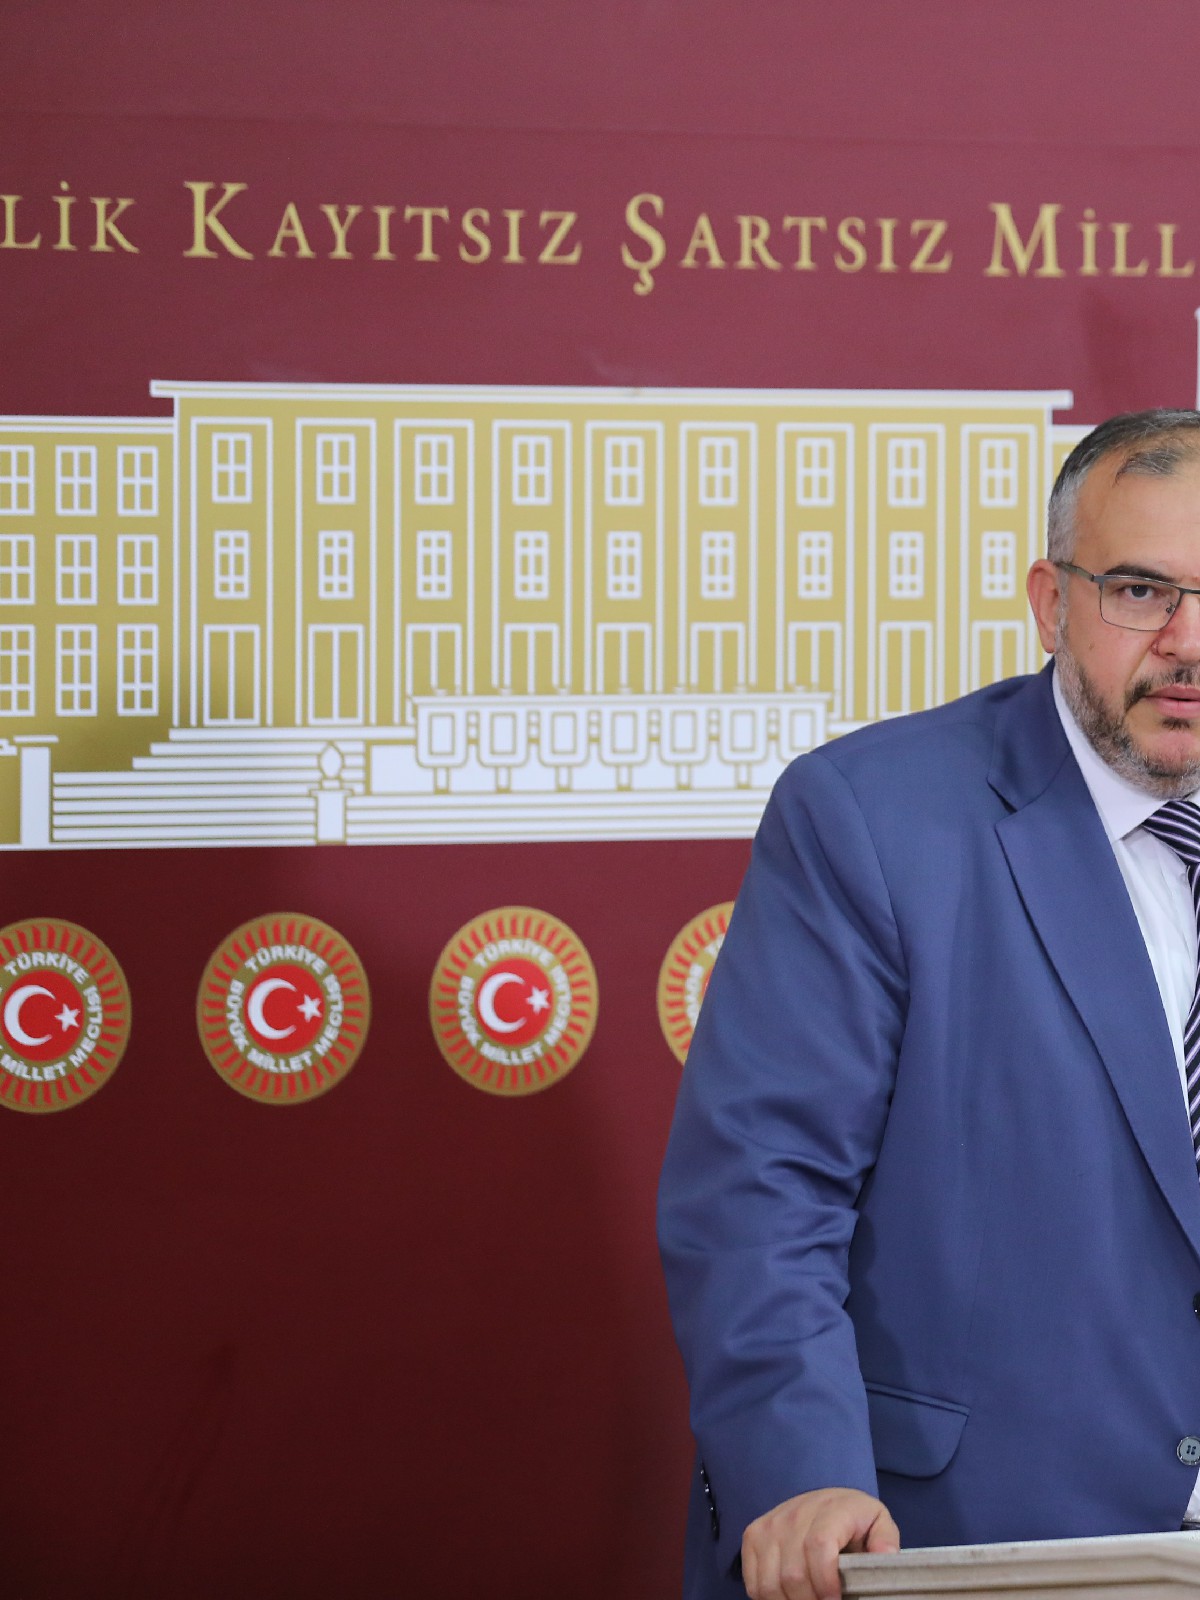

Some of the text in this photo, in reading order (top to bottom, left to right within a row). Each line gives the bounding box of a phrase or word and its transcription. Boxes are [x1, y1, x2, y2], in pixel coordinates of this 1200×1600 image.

[183, 181, 583, 265] KAYITSIZ
[621, 193, 953, 295] ŞARTSIZ
[3, 951, 90, 985] TÜRKİYE
[243, 944, 328, 975] TÜRKİYE
[473, 938, 556, 968] TÜRKİYE
[226, 979, 249, 1052] BÜYÜK
[457, 975, 482, 1048] BÜYÜK
[0, 1053, 67, 1082] MİLLET
[246, 1047, 313, 1074] MİLLET
[479, 1041, 544, 1067] MİLLET
